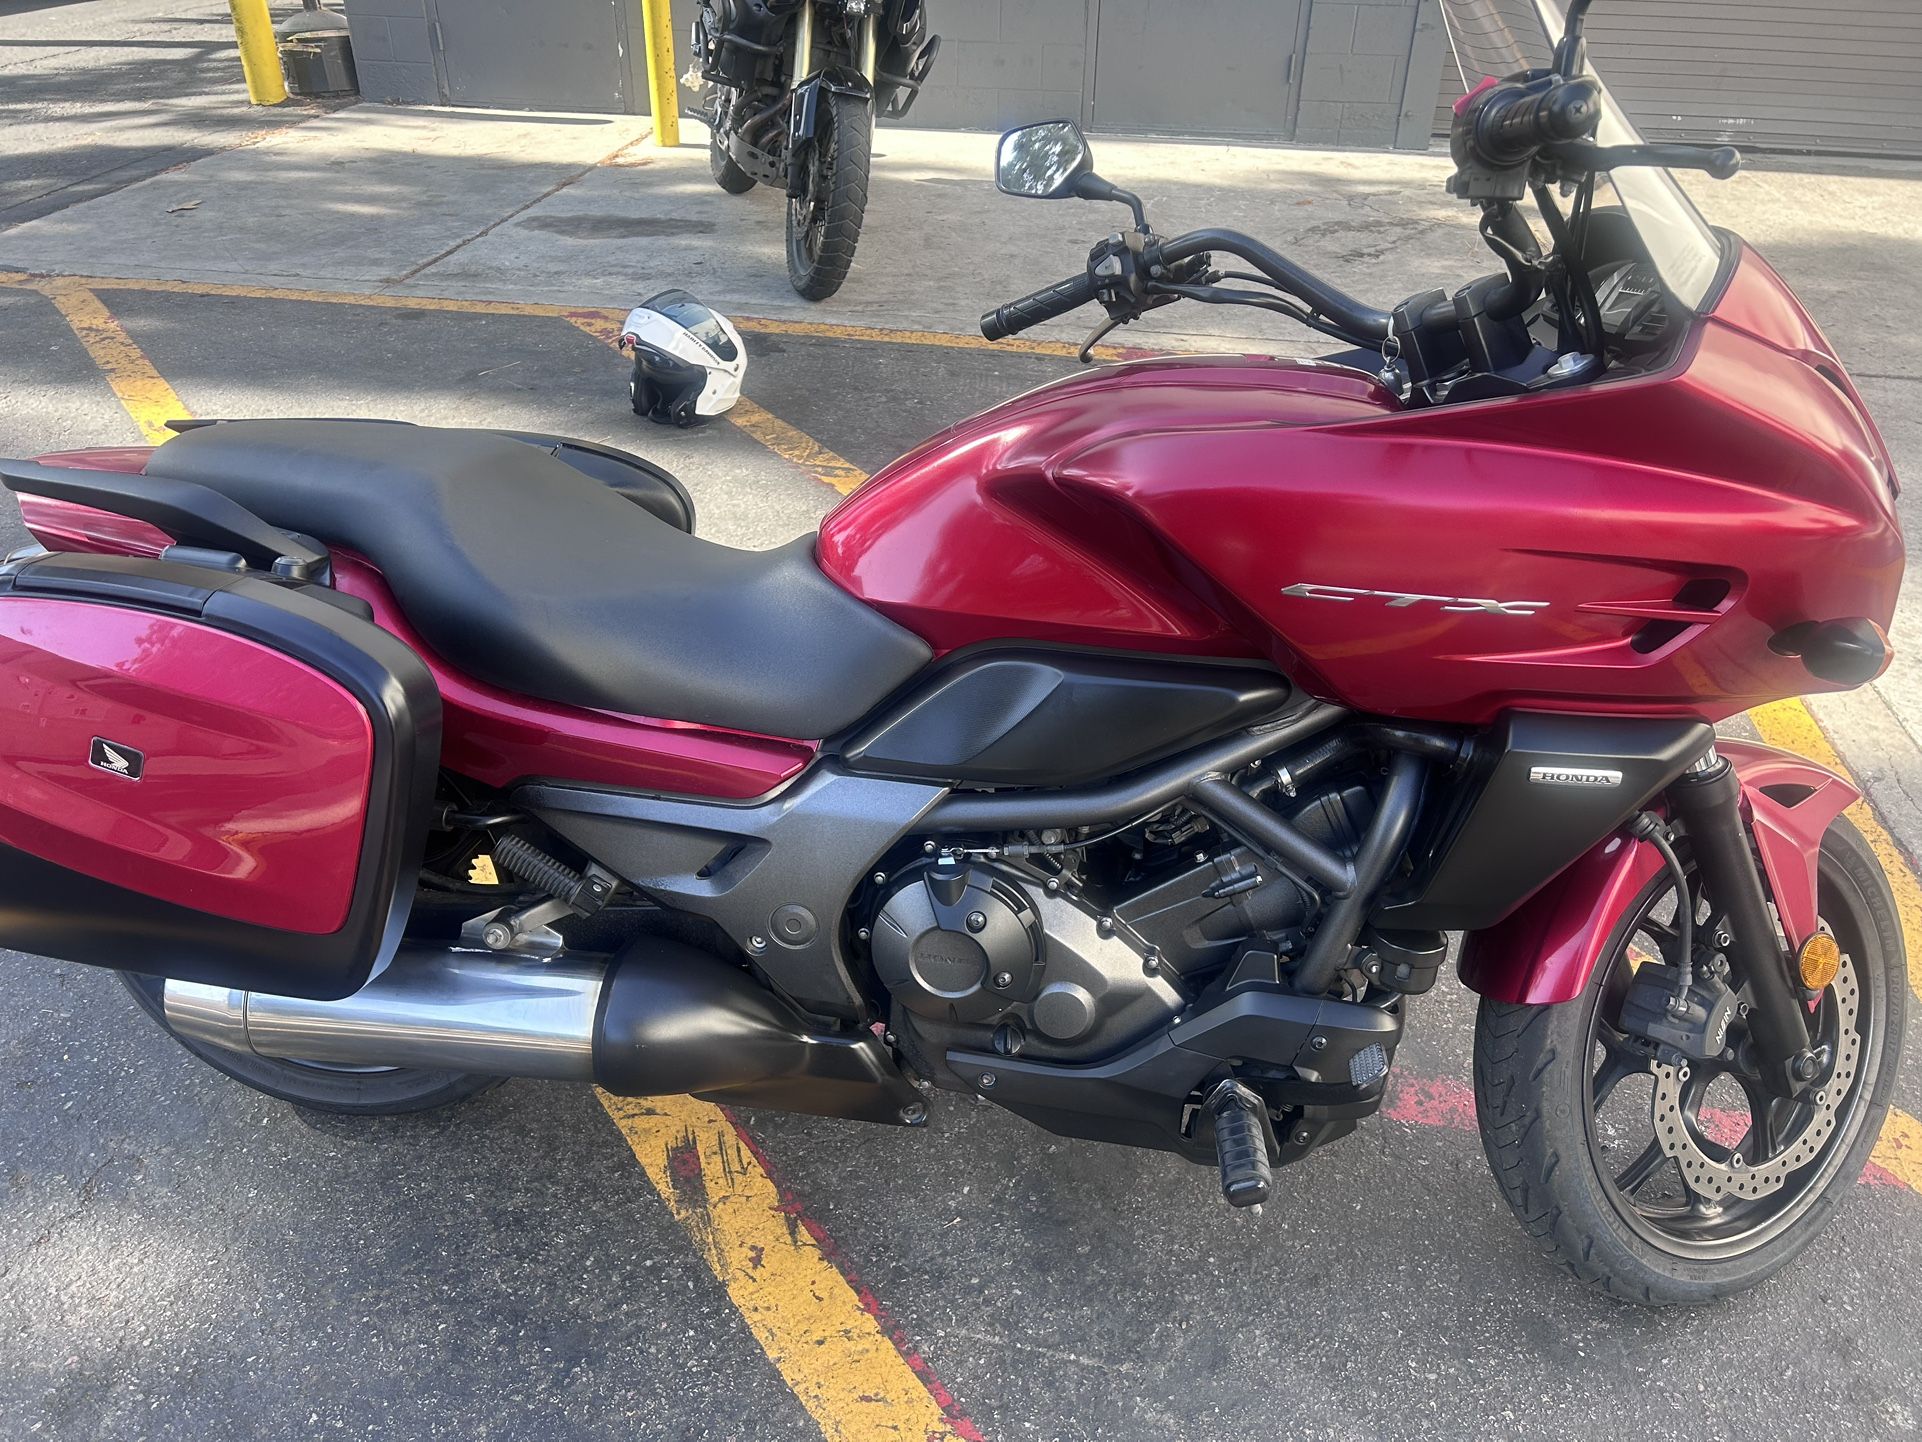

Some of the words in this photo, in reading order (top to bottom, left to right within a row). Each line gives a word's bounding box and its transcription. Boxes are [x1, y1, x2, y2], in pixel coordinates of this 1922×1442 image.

[1281, 583, 1551, 615] CTX
[100, 760, 129, 775] HONDA
[1540, 771, 1613, 785] HONDA
[1854, 866, 1898, 952] MICHELIN
